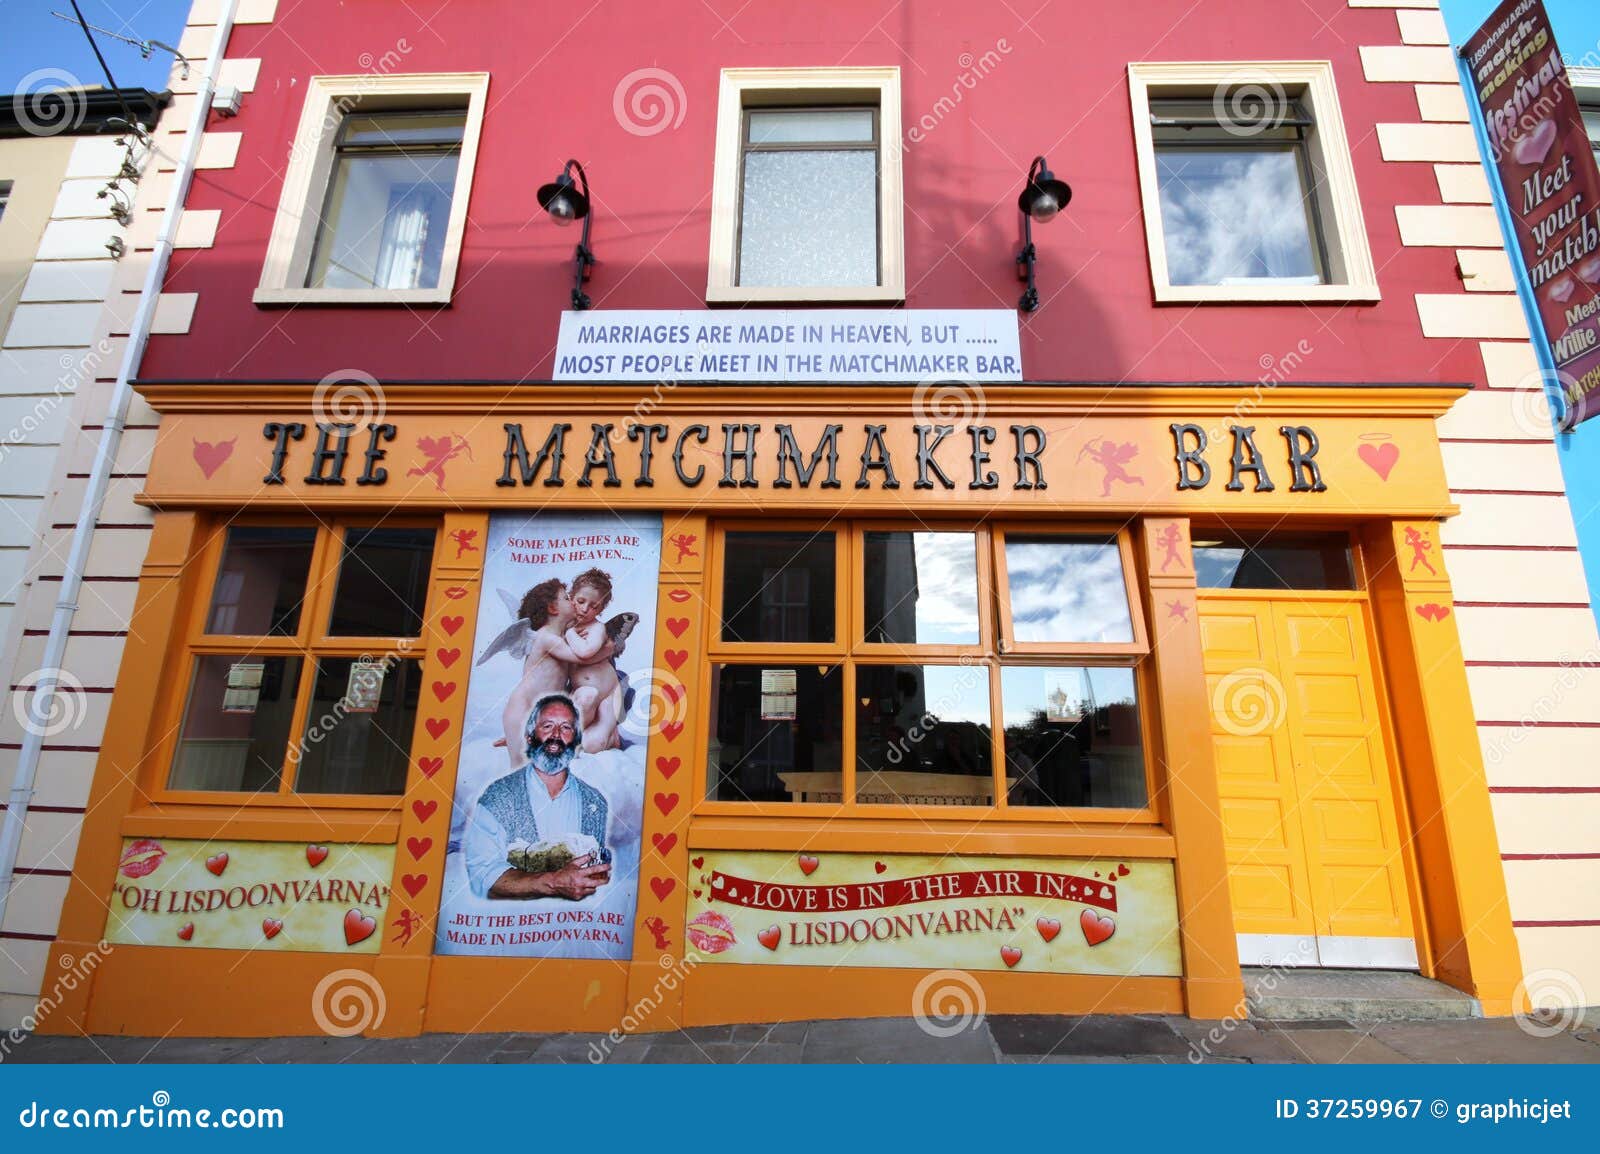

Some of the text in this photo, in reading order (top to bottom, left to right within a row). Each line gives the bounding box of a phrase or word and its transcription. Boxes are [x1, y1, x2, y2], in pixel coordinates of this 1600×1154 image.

[1476, 16, 1537, 83] match-
[1479, 27, 1548, 104] making
[1486, 48, 1562, 147] festival
[1522, 154, 1573, 216] Meet
[1531, 193, 1581, 256] your
[577, 325, 690, 343] MARRIAGES
[696, 325, 732, 343] ARE
[738, 325, 795, 343] MADE
[802, 325, 823, 343] IN
[831, 325, 912, 346] HEAVEN,
[921, 325, 959, 343] BUT
[1552, 328, 1597, 362] Willie
[559, 355, 1021, 374] MOST PEOPLE MEET IN THE MATCHMAKER BAR.
[263, 421, 1327, 493] THE MATCHMAKER BAR
[507, 535, 640, 549] SOME MATCHES ARE
[509, 552, 549, 564] MADE
[552, 553, 565, 563] IN
[752, 884, 818, 910] LOVE
[827, 887, 848, 909] IS
[858, 884, 886, 908] IN
[904, 874, 962, 901] THE
[973, 872, 1024, 895] AIR
[447, 928, 624, 946] MADE IN LISDOONVARNA.
[486, 915, 515, 927] THE
[518, 913, 553, 926] BEST
[556, 911, 593, 923] ONES
[597, 912, 625, 926] ARE
